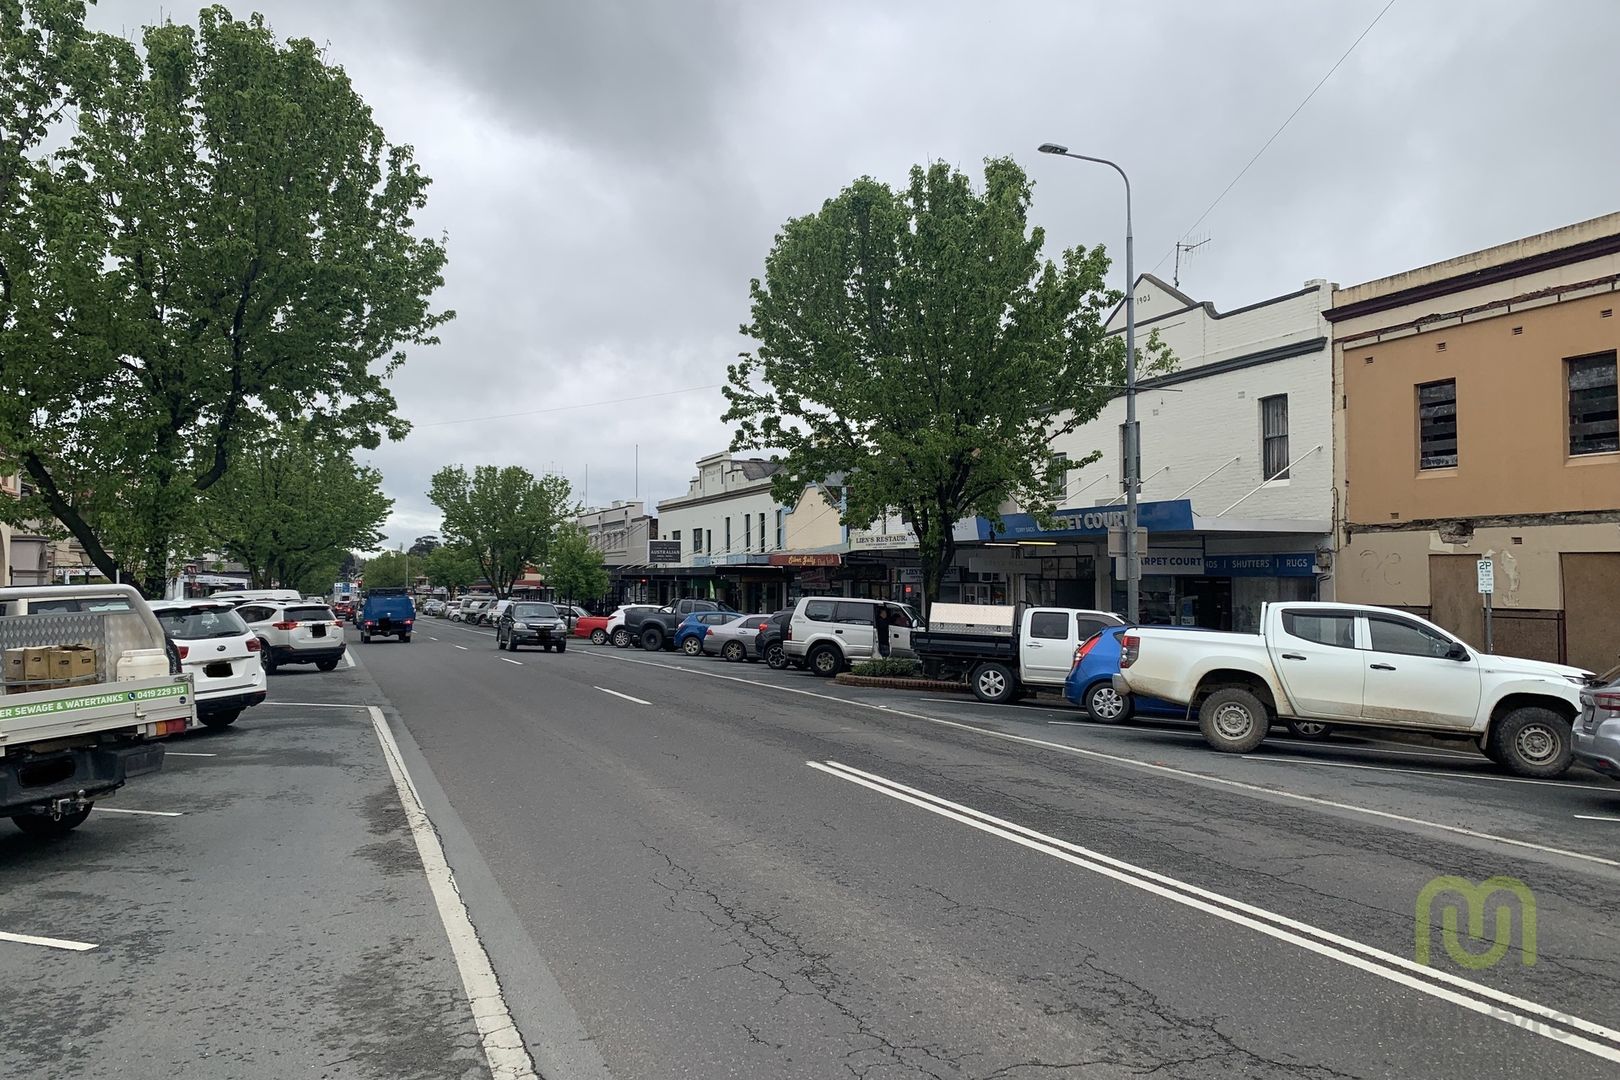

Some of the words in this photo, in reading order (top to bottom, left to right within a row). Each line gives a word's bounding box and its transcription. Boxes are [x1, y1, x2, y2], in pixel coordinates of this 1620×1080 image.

[1169, 557, 1202, 566] COURT
[1232, 559, 1270, 568] SHUTTERS
[1286, 558, 1308, 568] RUGS
[1479, 561, 1491, 569] 2P
[14, 703, 54, 716] SEWAGE
[56, 702, 63, 711] &
[65, 694, 124, 709] WATERTANKS
[137, 690, 156, 700] 0419
[156, 688, 172, 698] 229
[172, 686, 184, 695] 313
